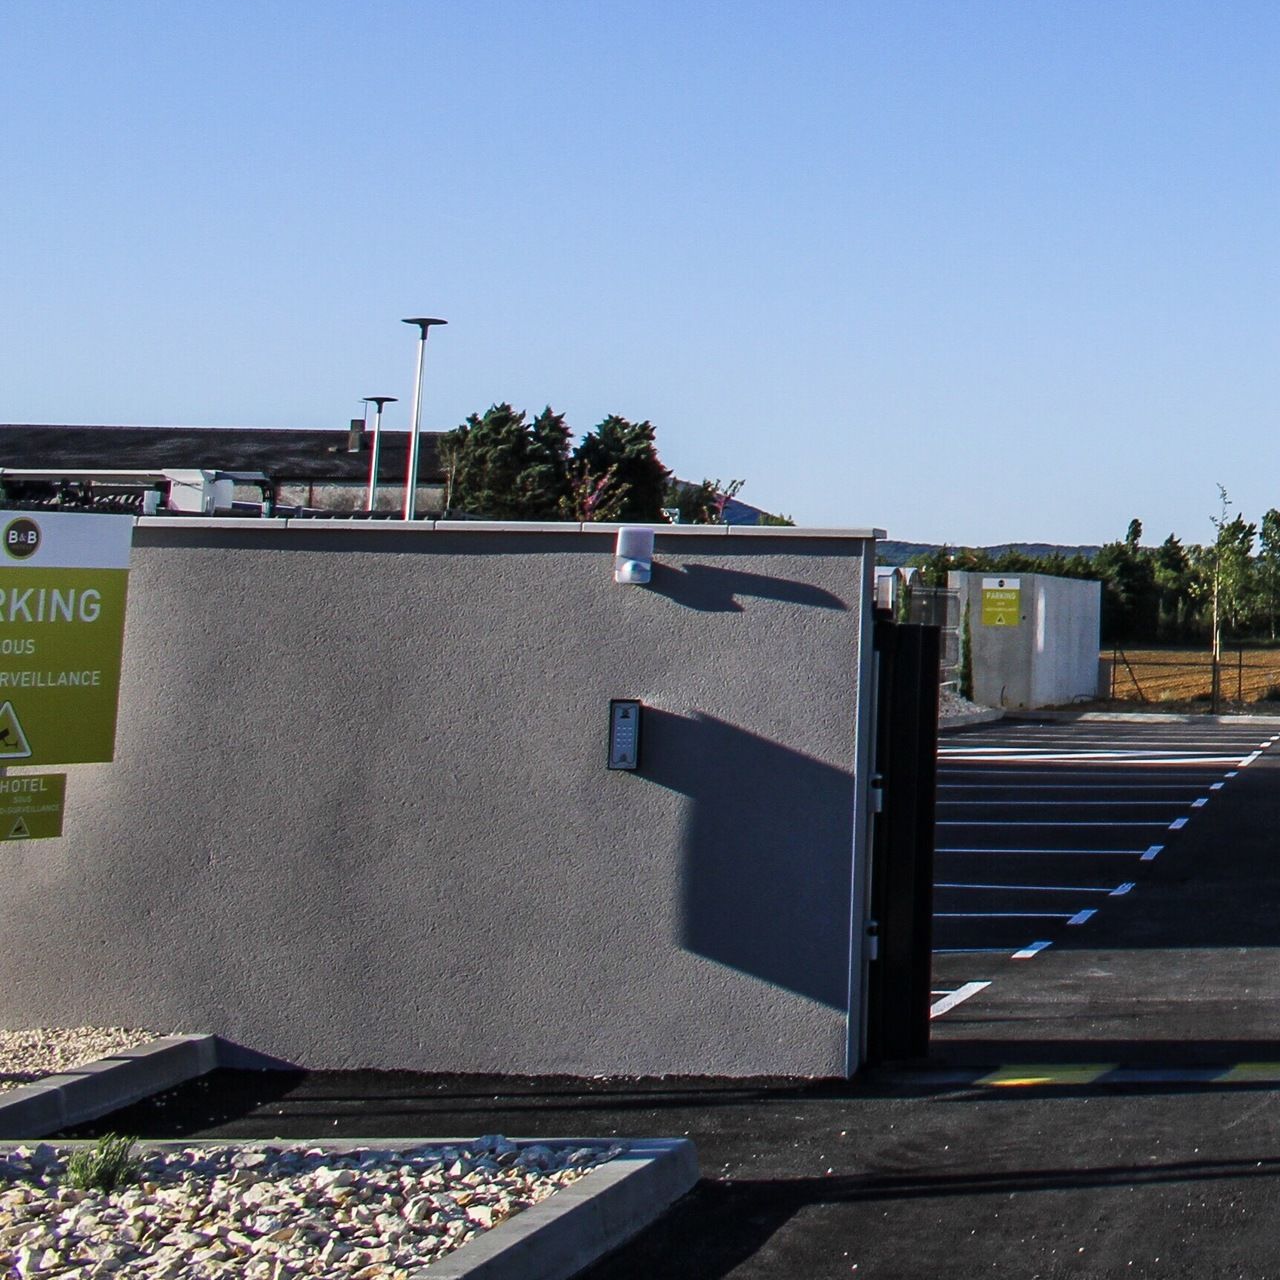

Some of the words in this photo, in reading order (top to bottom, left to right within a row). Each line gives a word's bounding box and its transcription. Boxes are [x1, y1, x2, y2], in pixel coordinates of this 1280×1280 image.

[8, 530, 37, 544] B&B
[0, 639, 36, 654] OUS
[0, 778, 48, 793] HOTEL
